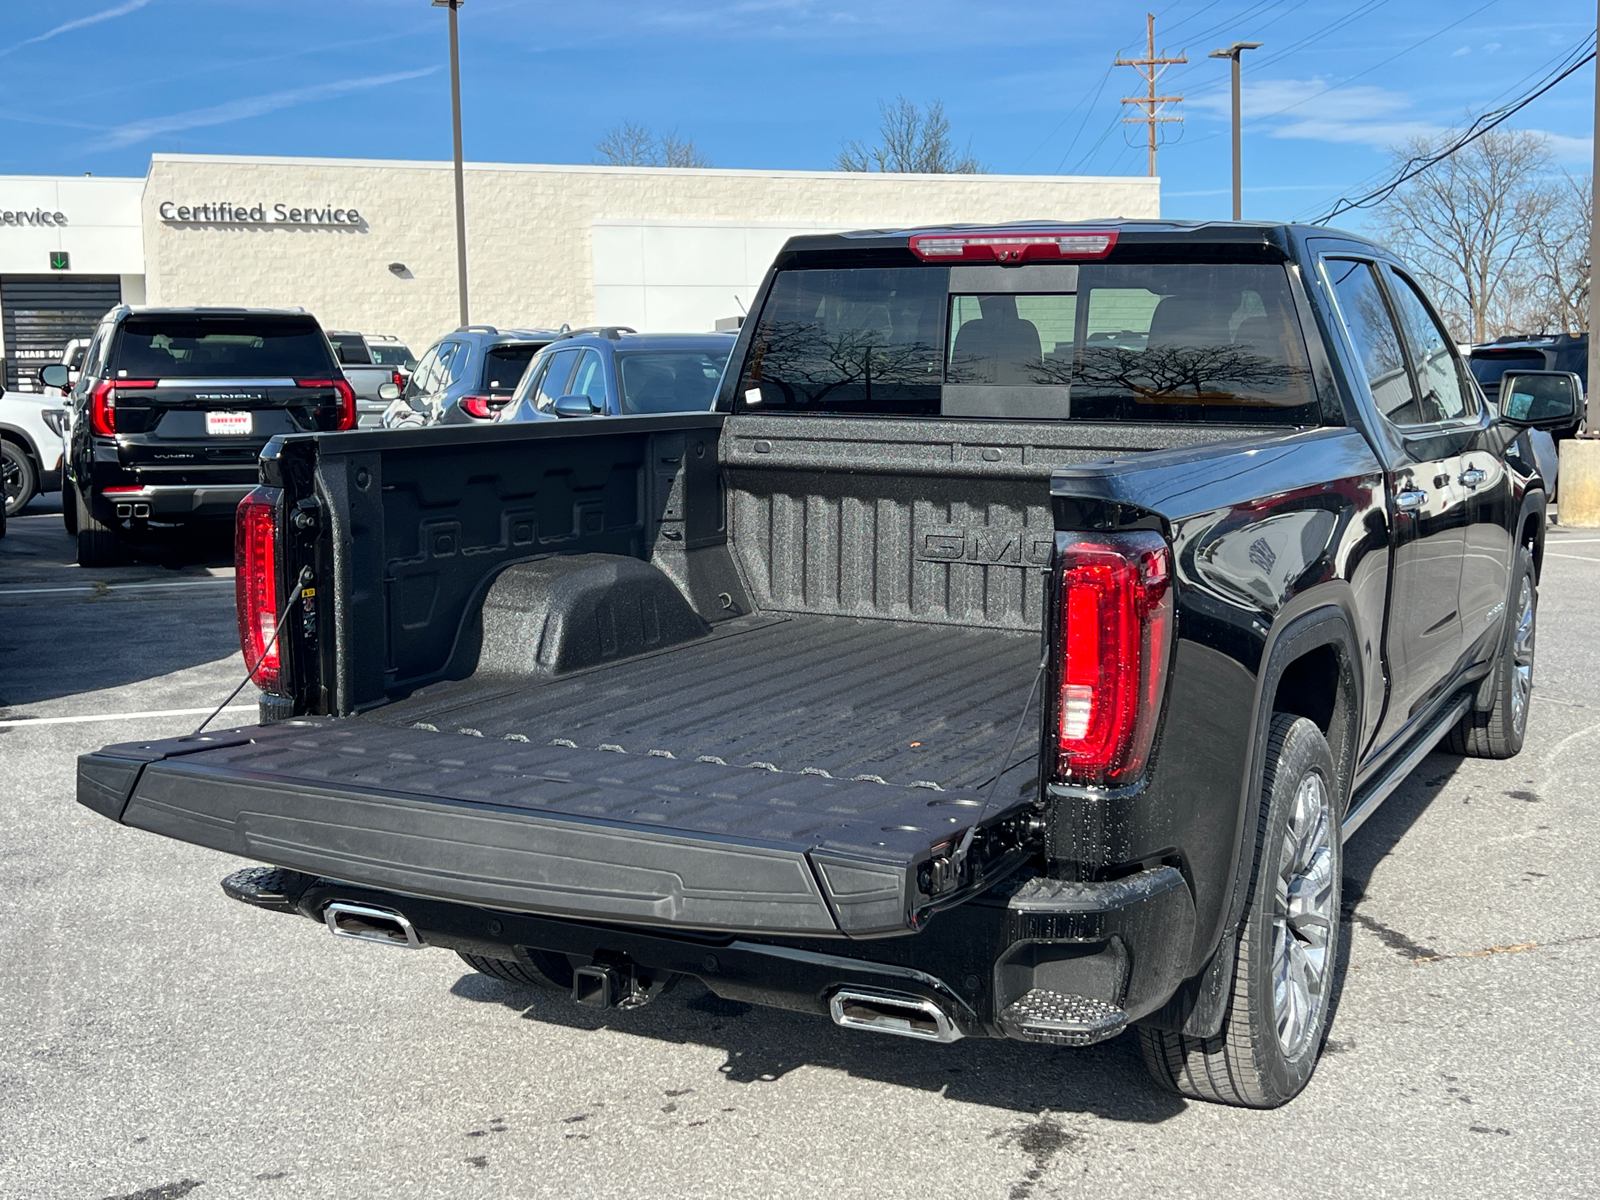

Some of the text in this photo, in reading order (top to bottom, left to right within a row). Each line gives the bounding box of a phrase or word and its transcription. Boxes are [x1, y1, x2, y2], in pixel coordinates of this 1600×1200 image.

[158, 201, 360, 223] Certified Service
[15, 350, 45, 359] PLEASE
[916, 524, 1054, 564] GMC
